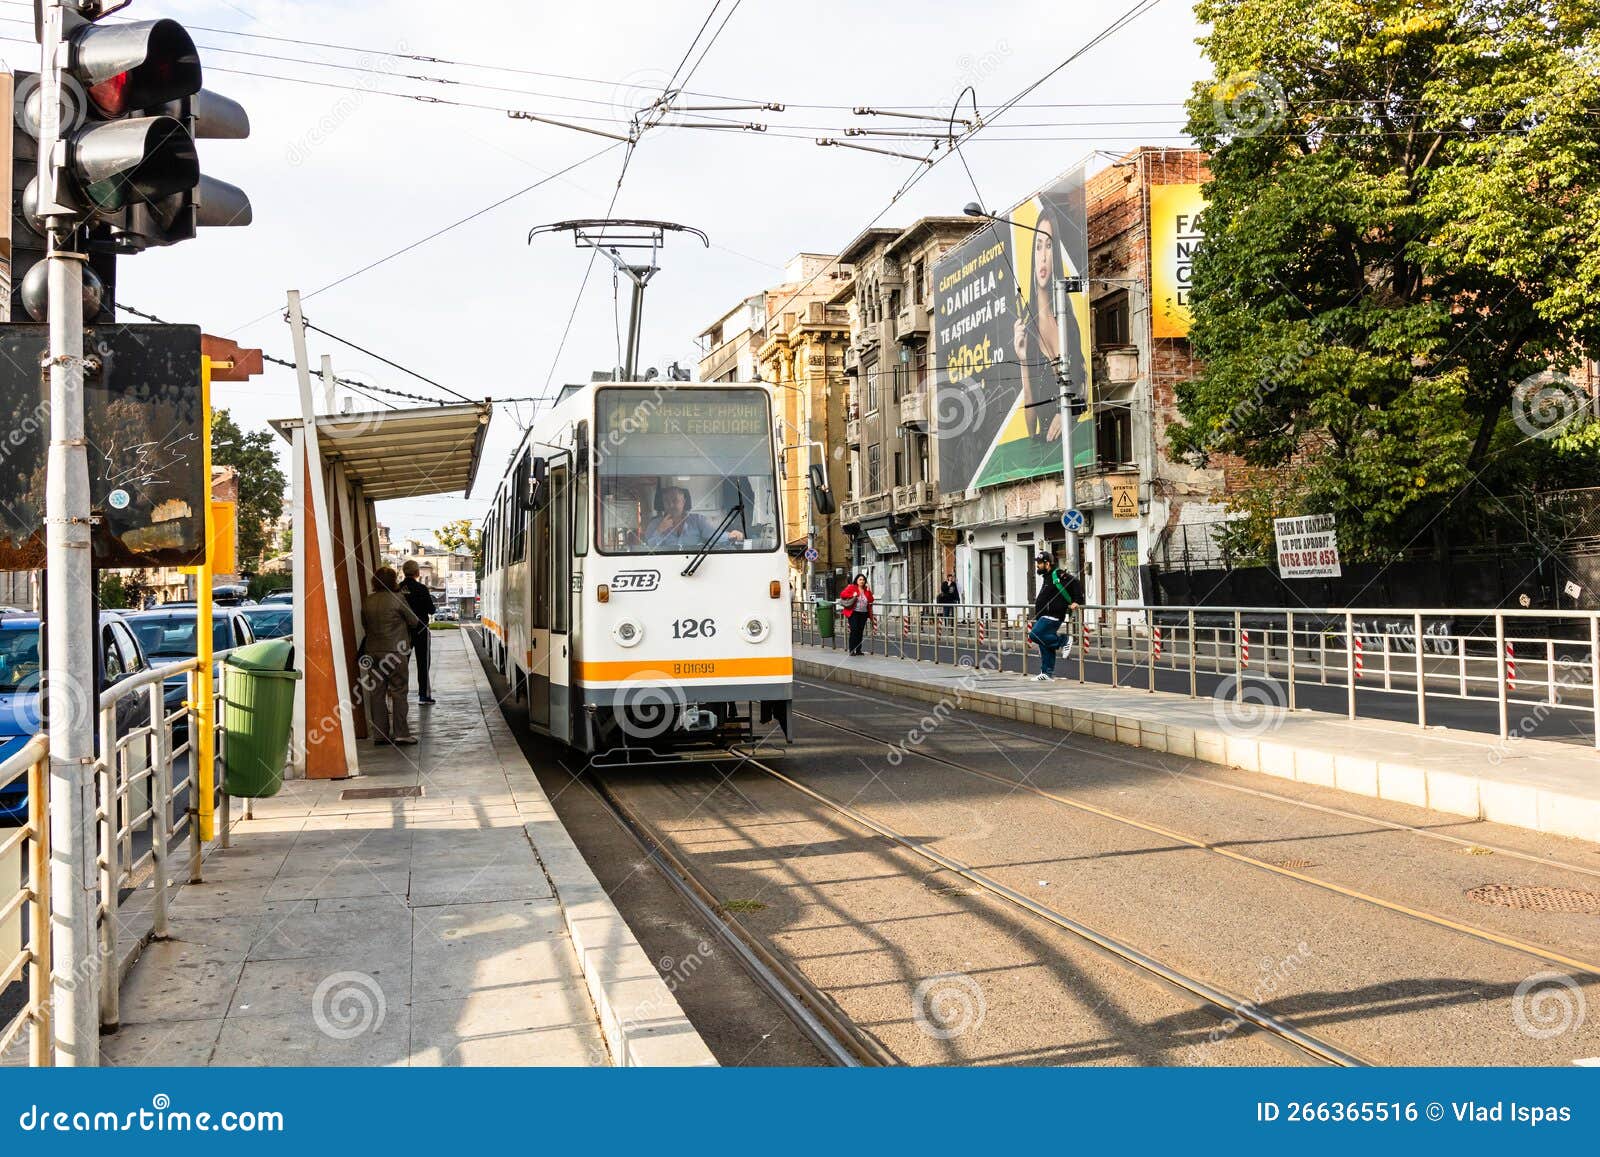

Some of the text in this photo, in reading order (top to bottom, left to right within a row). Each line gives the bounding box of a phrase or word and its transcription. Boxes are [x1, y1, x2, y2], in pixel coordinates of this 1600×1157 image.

[962, 259, 977, 278] SUNT
[947, 271, 996, 316] DANIELA
[941, 328, 950, 345] TE
[994, 296, 1006, 317] PE
[687, 419, 761, 434] FEBRUARIE
[1295, 520, 1304, 534] DE
[1303, 536, 1329, 549] APROBAT
[1280, 549, 1336, 568] 0752 925 853
[672, 618, 717, 639] 126
[674, 663, 681, 674] B
